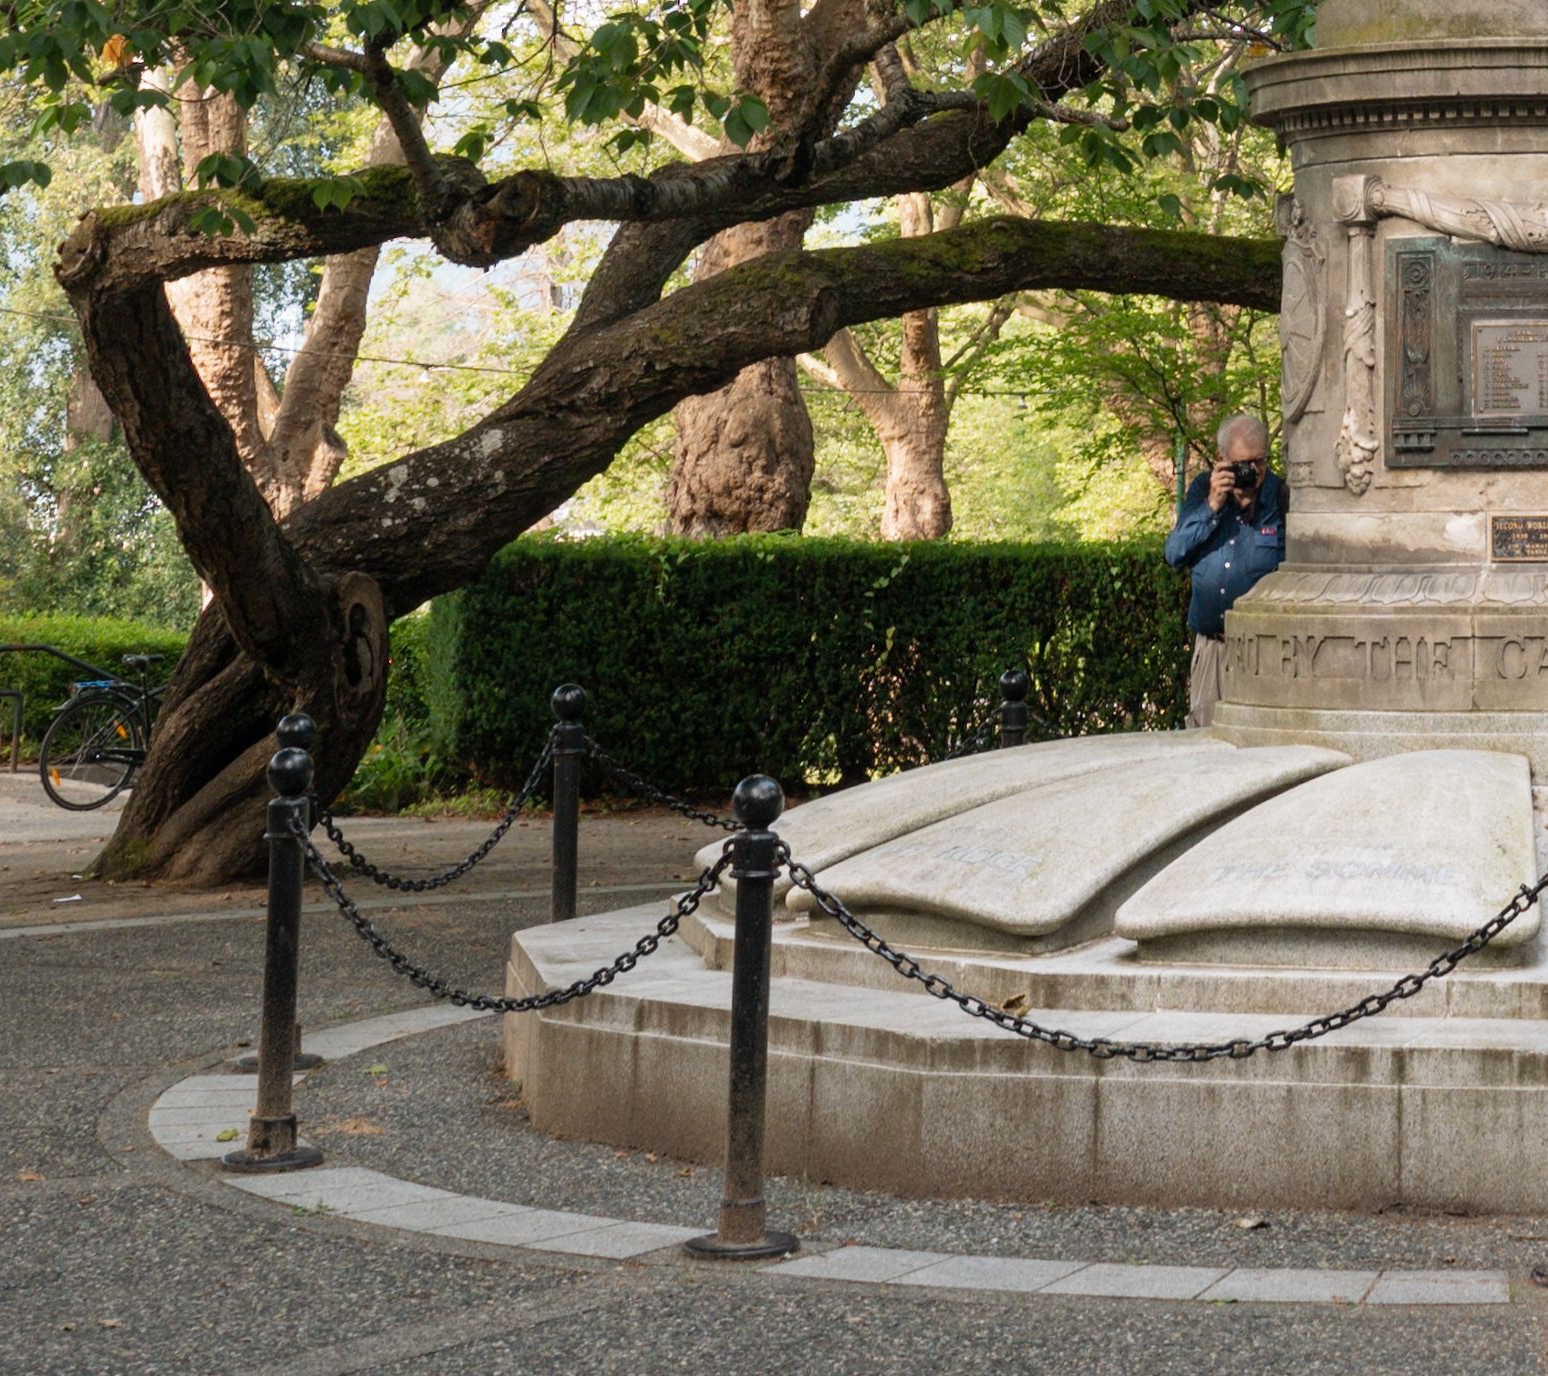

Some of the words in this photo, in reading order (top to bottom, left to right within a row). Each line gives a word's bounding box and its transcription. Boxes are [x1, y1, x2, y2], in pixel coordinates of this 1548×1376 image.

[1494, 521, 1523, 530] SECOND
[1353, 635, 1452, 681] THE
[1212, 862, 1289, 882] THE
[1305, 861, 1467, 886] SOMME
